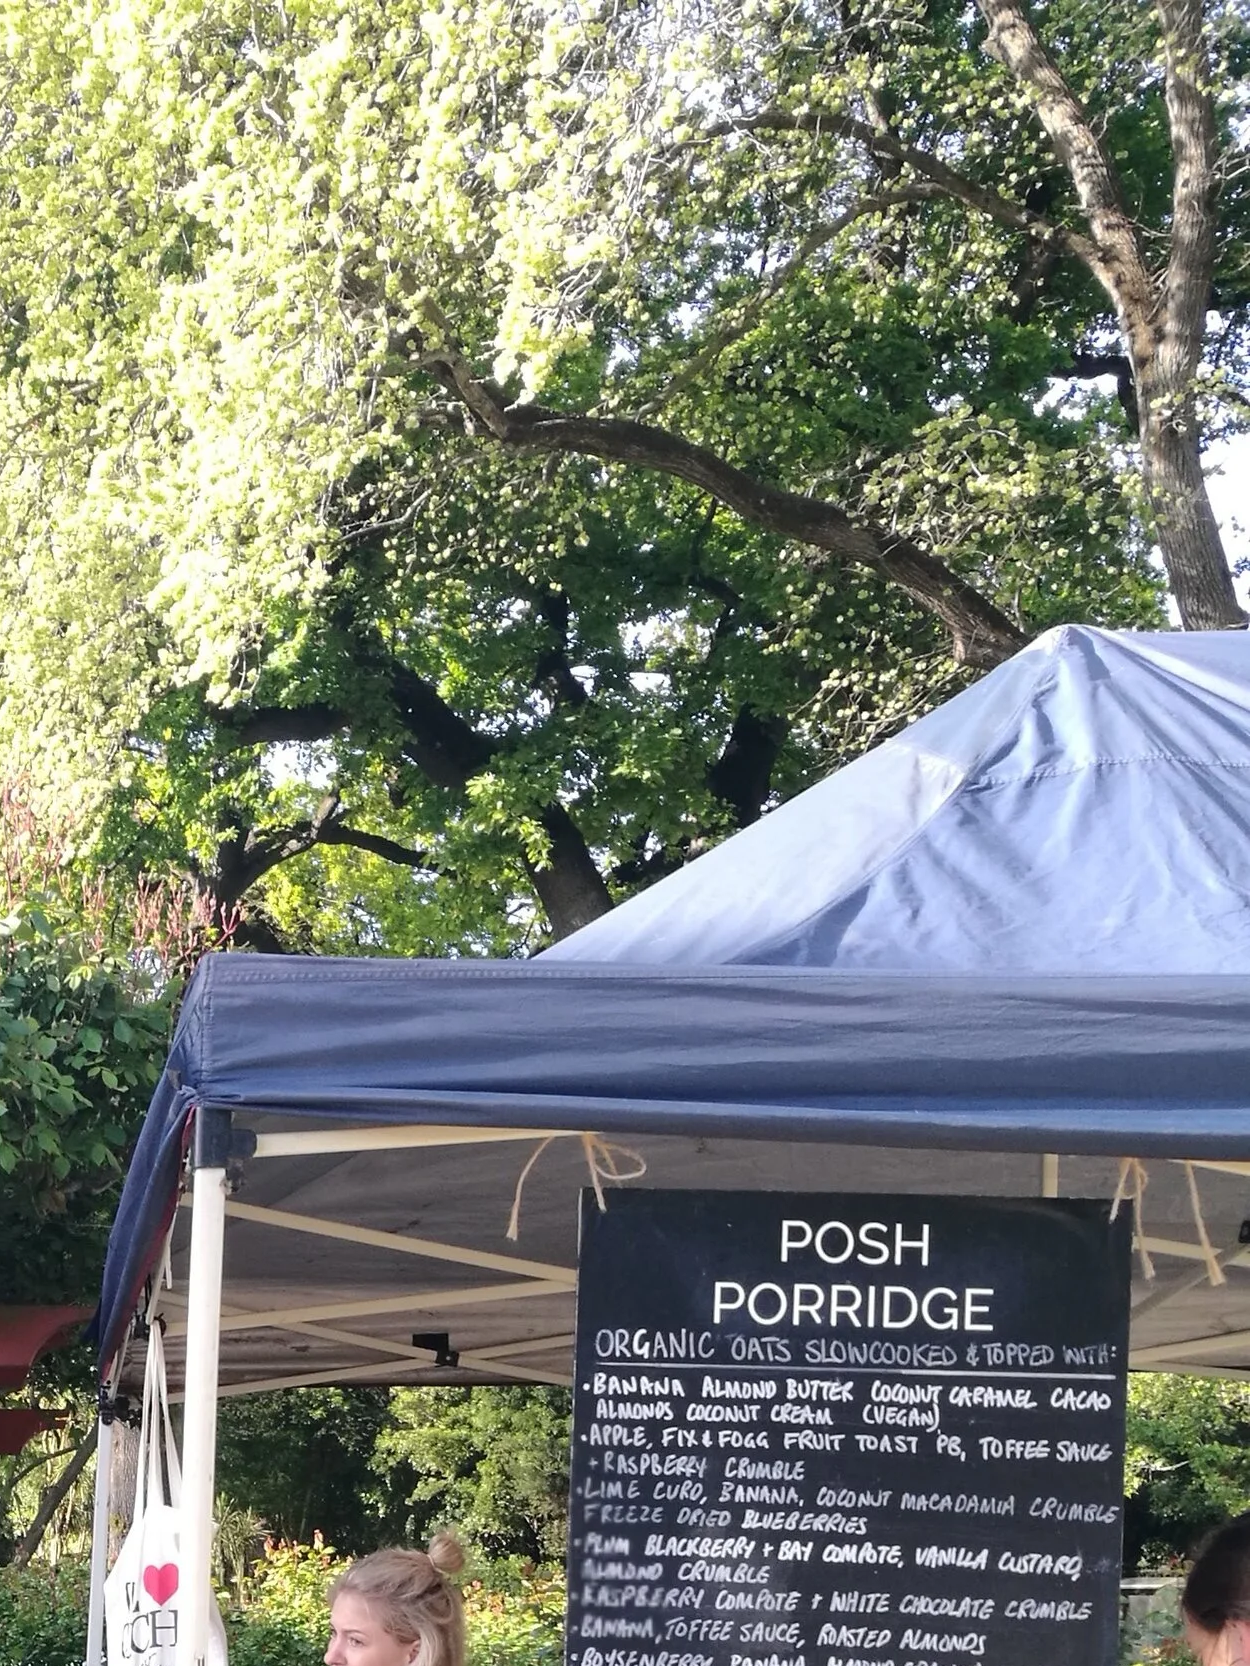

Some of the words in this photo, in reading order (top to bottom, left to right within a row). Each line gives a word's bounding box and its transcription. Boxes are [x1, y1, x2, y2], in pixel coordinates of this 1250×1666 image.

[780, 1219, 930, 1267] POSH
[713, 1282, 994, 1332] PORRIDGE
[595, 1328, 715, 1360] ORGANIC
[730, 1336, 792, 1363] OATS
[805, 1338, 958, 1367] SLOWCOOKED
[966, 1343, 979, 1366] &
[982, 1343, 1054, 1367] TOPPED
[1062, 1345, 1117, 1365] WITH:
[593, 1375, 684, 1398] BANANA
[702, 1377, 776, 1400] ALMOND
[786, 1379, 854, 1402] BUTTER
[871, 1380, 942, 1404] COCONUT
[949, 1386, 1037, 1408] CARAMEL
[1051, 1387, 1112, 1411] CACAO
[596, 1399, 674, 1421] ALMONDS
[686, 1403, 760, 1422] COCONUT
[770, 1405, 834, 1425] CREAM
[862, 1405, 940, 1432] (VEGAN)
[590, 1425, 654, 1450] APPLE,
[661, 1427, 698, 1448] FIX
[718, 1430, 769, 1449] FOGG
[783, 1429, 845, 1451] FRUIT
[855, 1434, 918, 1453] TOAST
[936, 1434, 966, 1461] PB,
[979, 1436, 1051, 1460] TOFFEE
[1056, 1441, 1112, 1462] SAUCE
[603, 1450, 707, 1478] RASPBERRY
[725, 1456, 805, 1481] CRUMBLE
[583, 1504, 664, 1524] FREEZE
[676, 1507, 731, 1527] DRIED
[742, 1510, 867, 1535] BLUEBERRIES
[584, 1479, 640, 1500] LIME
[816, 1487, 892, 1508] COCONUT
[900, 1493, 1015, 1516] MACADAMIA
[1029, 1497, 1120, 1524] CRUMBLE
[584, 1532, 630, 1555] PLUM
[644, 1535, 756, 1559] BLACKBERRY
[778, 1541, 814, 1562] BAY
[822, 1543, 904, 1568] COMPOTE,
[916, 1546, 988, 1570] VANILLA
[677, 1562, 770, 1584] CRUMBLE
[582, 1585, 703, 1609] RASPBERRY
[715, 1589, 801, 1612] COMPOTE
[830, 1591, 890, 1613] WHITE
[899, 1594, 994, 1620] CHOCOLATE
[1005, 1599, 1092, 1621] CRUMBLE
[664, 1616, 733, 1641] TOFFEE
[739, 1622, 806, 1649] SAUCE,
[817, 1625, 891, 1651] ROASTED
[900, 1629, 987, 1655] ALMONDS
